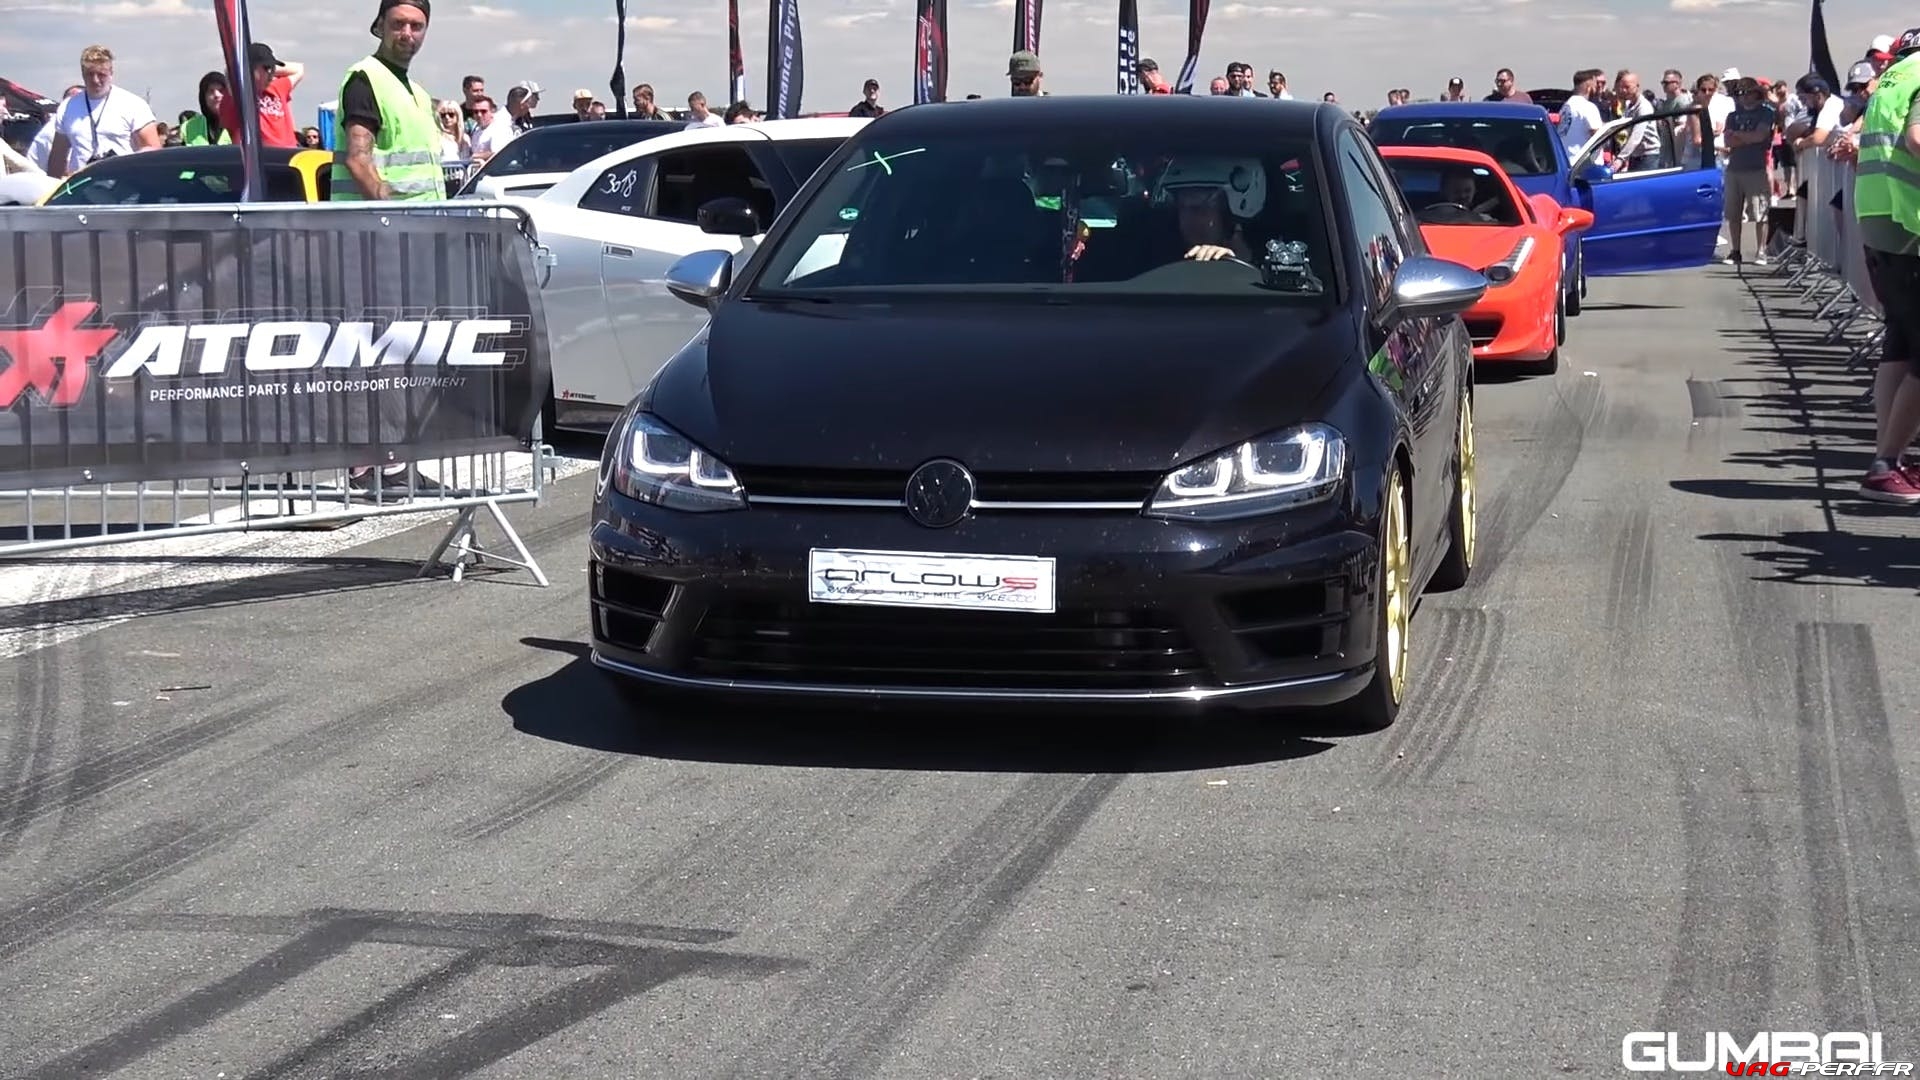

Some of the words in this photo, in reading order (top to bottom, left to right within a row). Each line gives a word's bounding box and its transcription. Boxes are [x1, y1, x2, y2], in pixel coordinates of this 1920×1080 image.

[105, 318, 512, 378] ATOMIC
[150, 385, 245, 401] PERFORMANCE
[248, 382, 288, 397] PARTS
[292, 382, 302, 395] &
[306, 377, 391, 394] MOTORSPORT
[393, 376, 467, 390] EQUIPMENT
